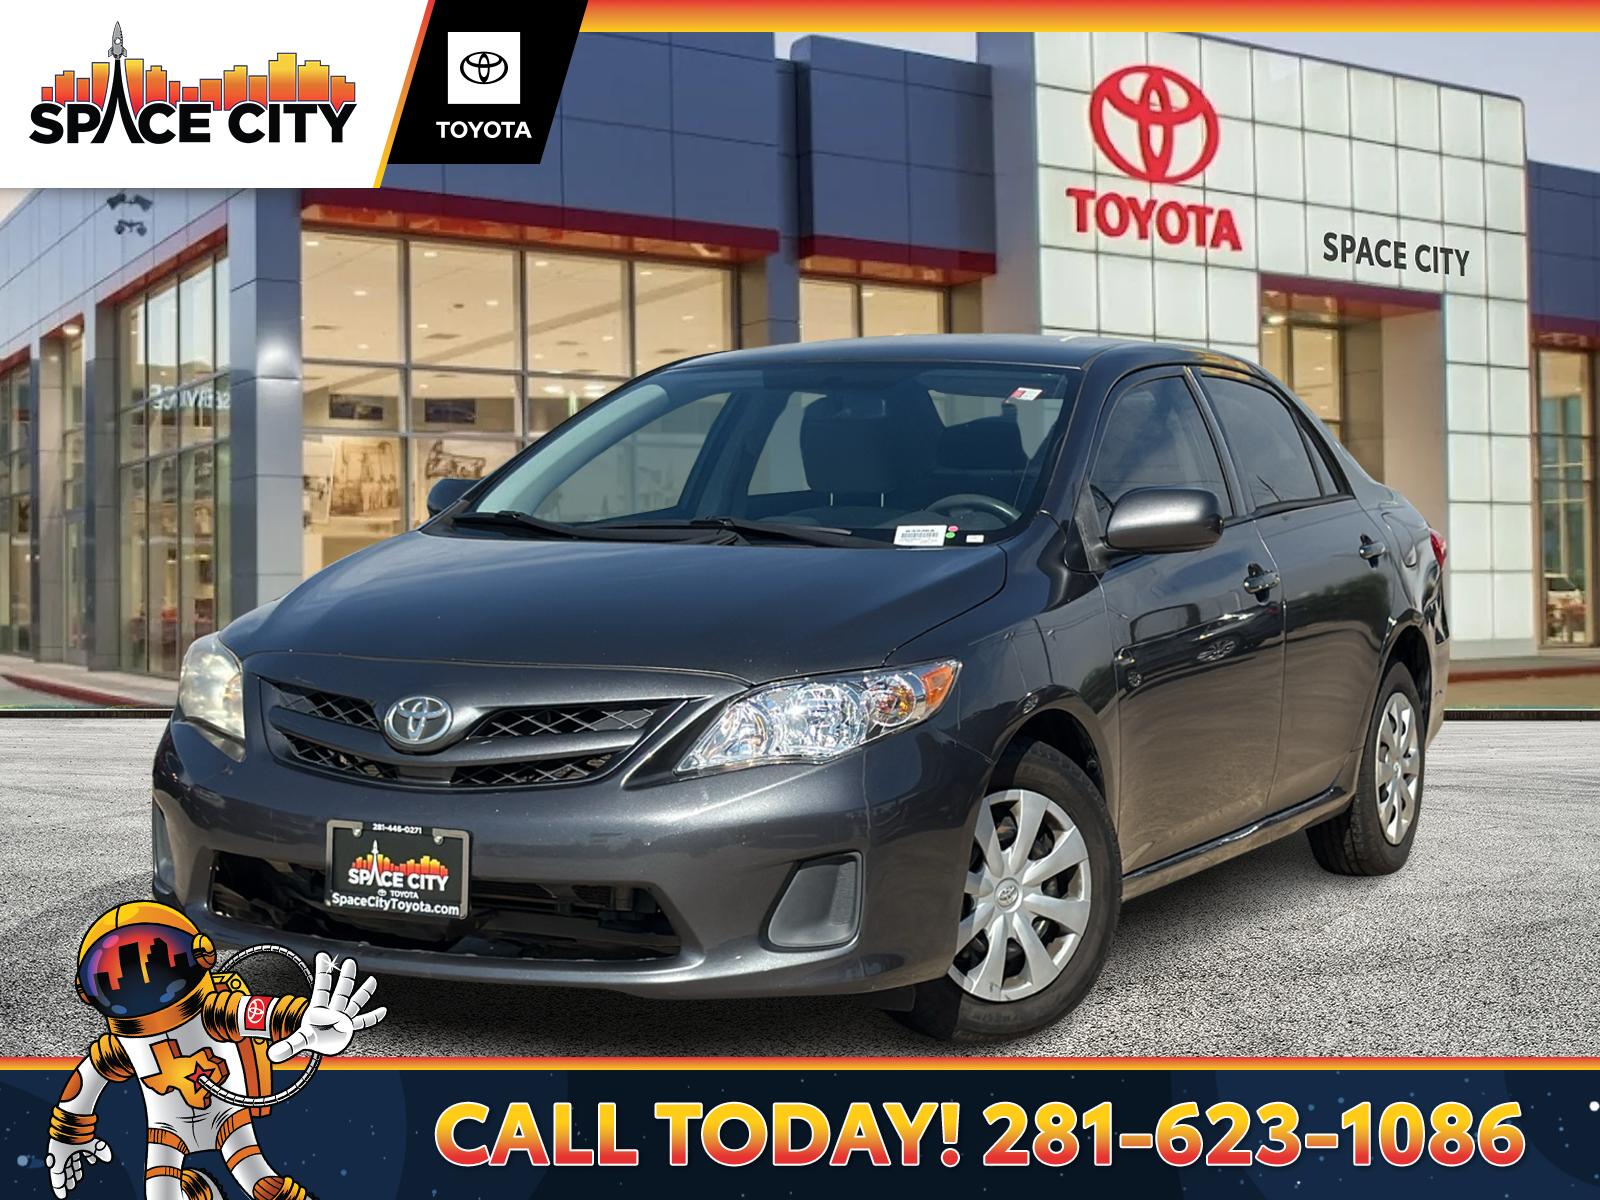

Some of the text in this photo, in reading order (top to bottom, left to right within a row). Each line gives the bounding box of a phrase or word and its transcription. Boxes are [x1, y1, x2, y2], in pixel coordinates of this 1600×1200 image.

[1066, 188, 1242, 251] TOYOTA
[1323, 232, 1470, 276] SPACE CITY
[407, 873, 449, 891] CITY
[332, 892, 459, 915] SpaceCityToyota.com
[390, 890, 419, 899] TOYOTA
